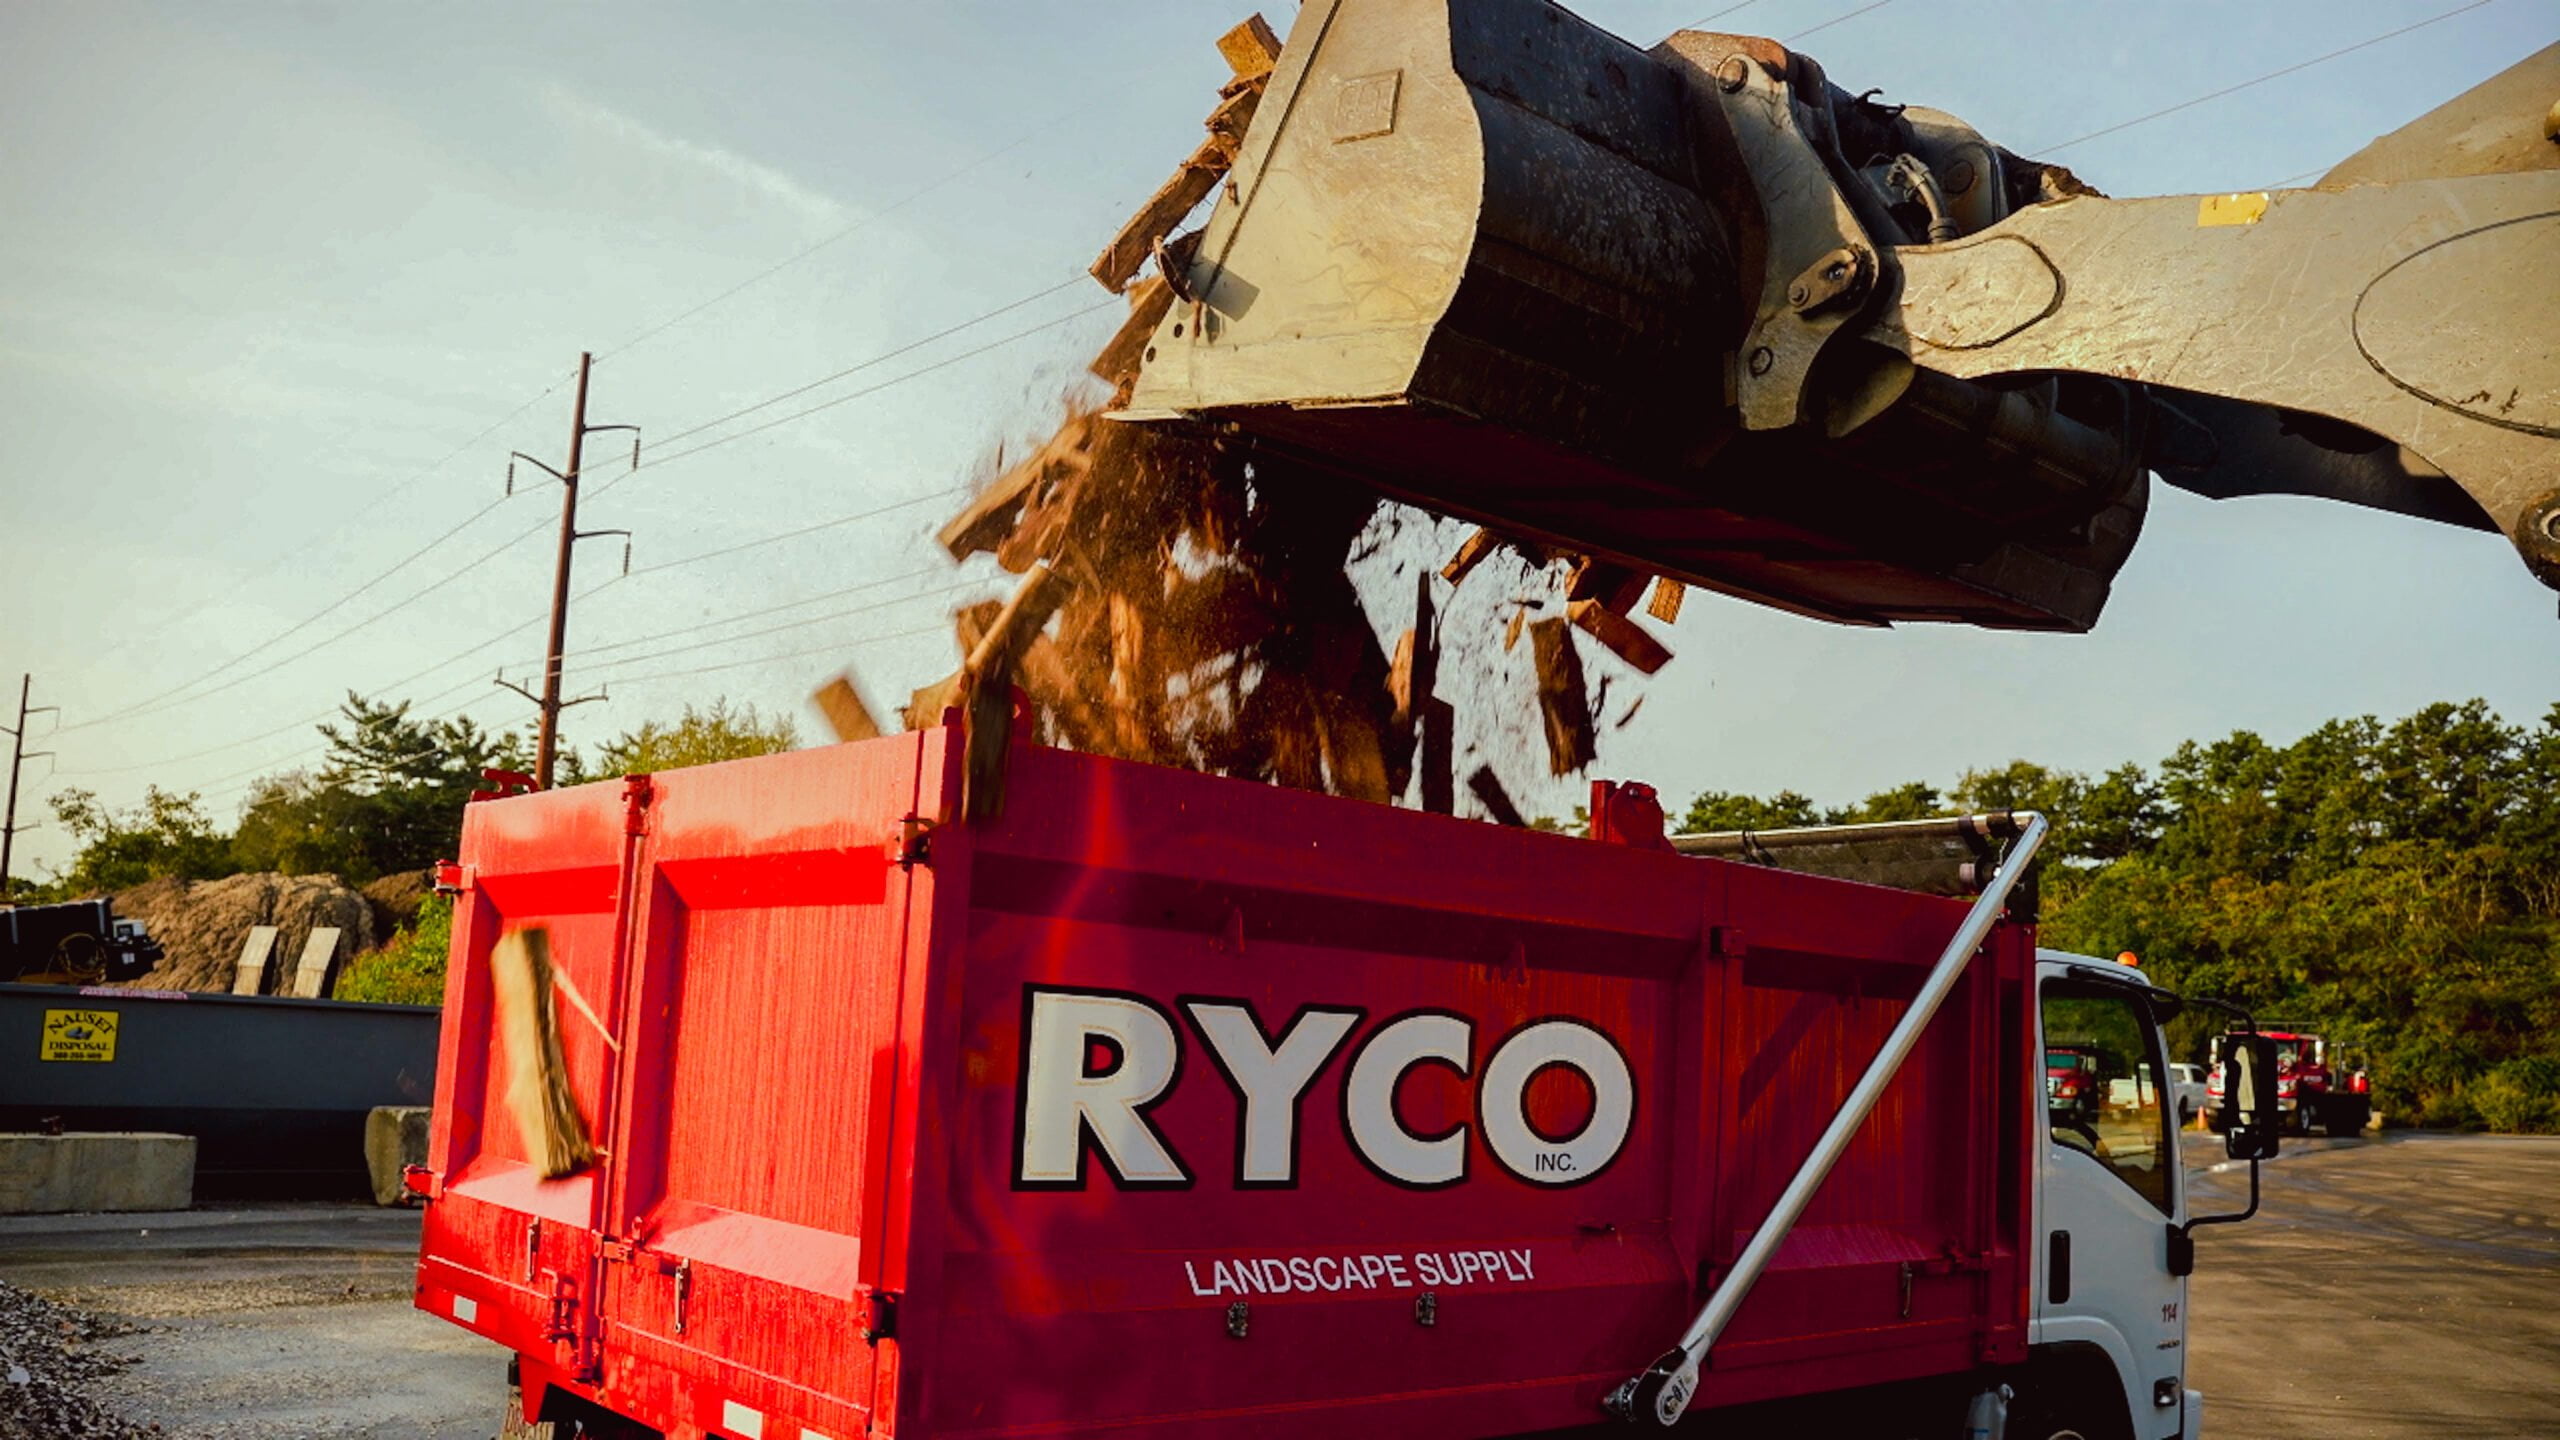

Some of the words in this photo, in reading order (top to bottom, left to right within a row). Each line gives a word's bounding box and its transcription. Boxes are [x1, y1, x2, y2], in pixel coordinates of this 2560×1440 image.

[48, 1012, 116, 1035] NAUSET
[48, 1041, 111, 1051] DISPOSAL
[1012, 983, 1638, 1190] RYCO
[1535, 1153, 1577, 1171] INC.
[1185, 1255, 1412, 1296] LANDSCAPE
[1415, 1249, 1535, 1287] SUPPLY
[2161, 1302, 2178, 1322] 114
